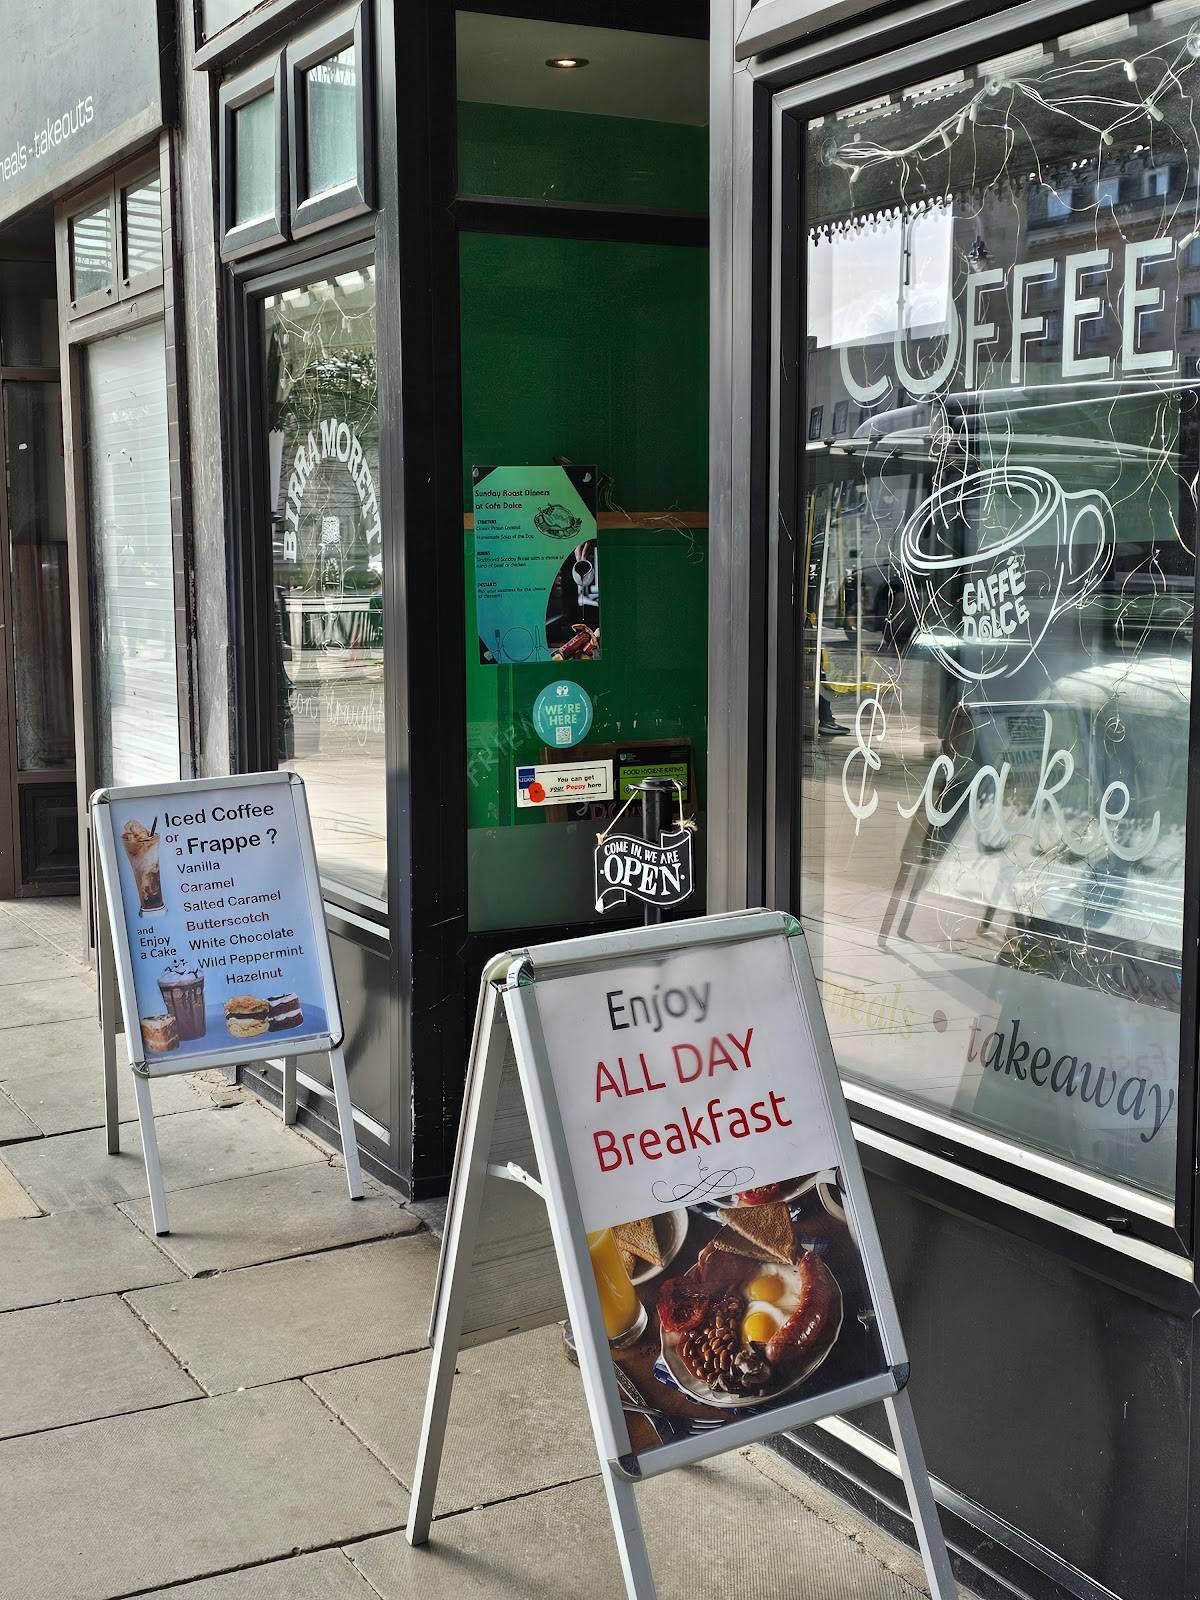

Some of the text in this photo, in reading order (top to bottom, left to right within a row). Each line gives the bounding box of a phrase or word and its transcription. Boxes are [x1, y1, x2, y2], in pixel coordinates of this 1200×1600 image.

[34, 95, 94, 158] takeouts
[839, 236, 1178, 407] COFFEE
[475, 490, 501, 498] Sunday
[503, 489, 523, 497] Roast
[962, 596, 1030, 642] DOLCE
[545, 703, 581, 716] WE'RE
[549, 714, 577, 726] HERE
[584, 774, 595, 782] get
[641, 767, 664, 775] HYGIENE
[550, 785, 565, 793] your
[566, 783, 586, 791] Poppy
[897, 709, 1160, 861] cake
[165, 802, 275, 828] Iced Coffee
[165, 833, 179, 844] or
[175, 846, 184, 856] a
[187, 833, 262, 855] Frappe
[604, 841, 629, 856] COME
[644, 849, 658, 863] WE
[660, 850, 680, 865] ARE
[177, 860, 221, 875] Vanilla
[603, 854, 683, 896] OPEN
[180, 877, 235, 894] Caramel
[183, 889, 282, 913] Salted Caramel
[137, 926, 154, 936] and
[186, 911, 271, 932] Butterscotch
[139, 935, 171, 948] Enjoy
[189, 927, 295, 951] White Chocolate
[140, 946, 177, 960] a Cake
[197, 945, 304, 969] Wild Peppermint
[226, 967, 284, 985] Hazelnut
[606, 981, 712, 1033] Enjoy
[594, 1027, 755, 1104] ALL DAY
[966, 1015, 1175, 1143] takeaway
[592, 1090, 793, 1174] Breakfast
